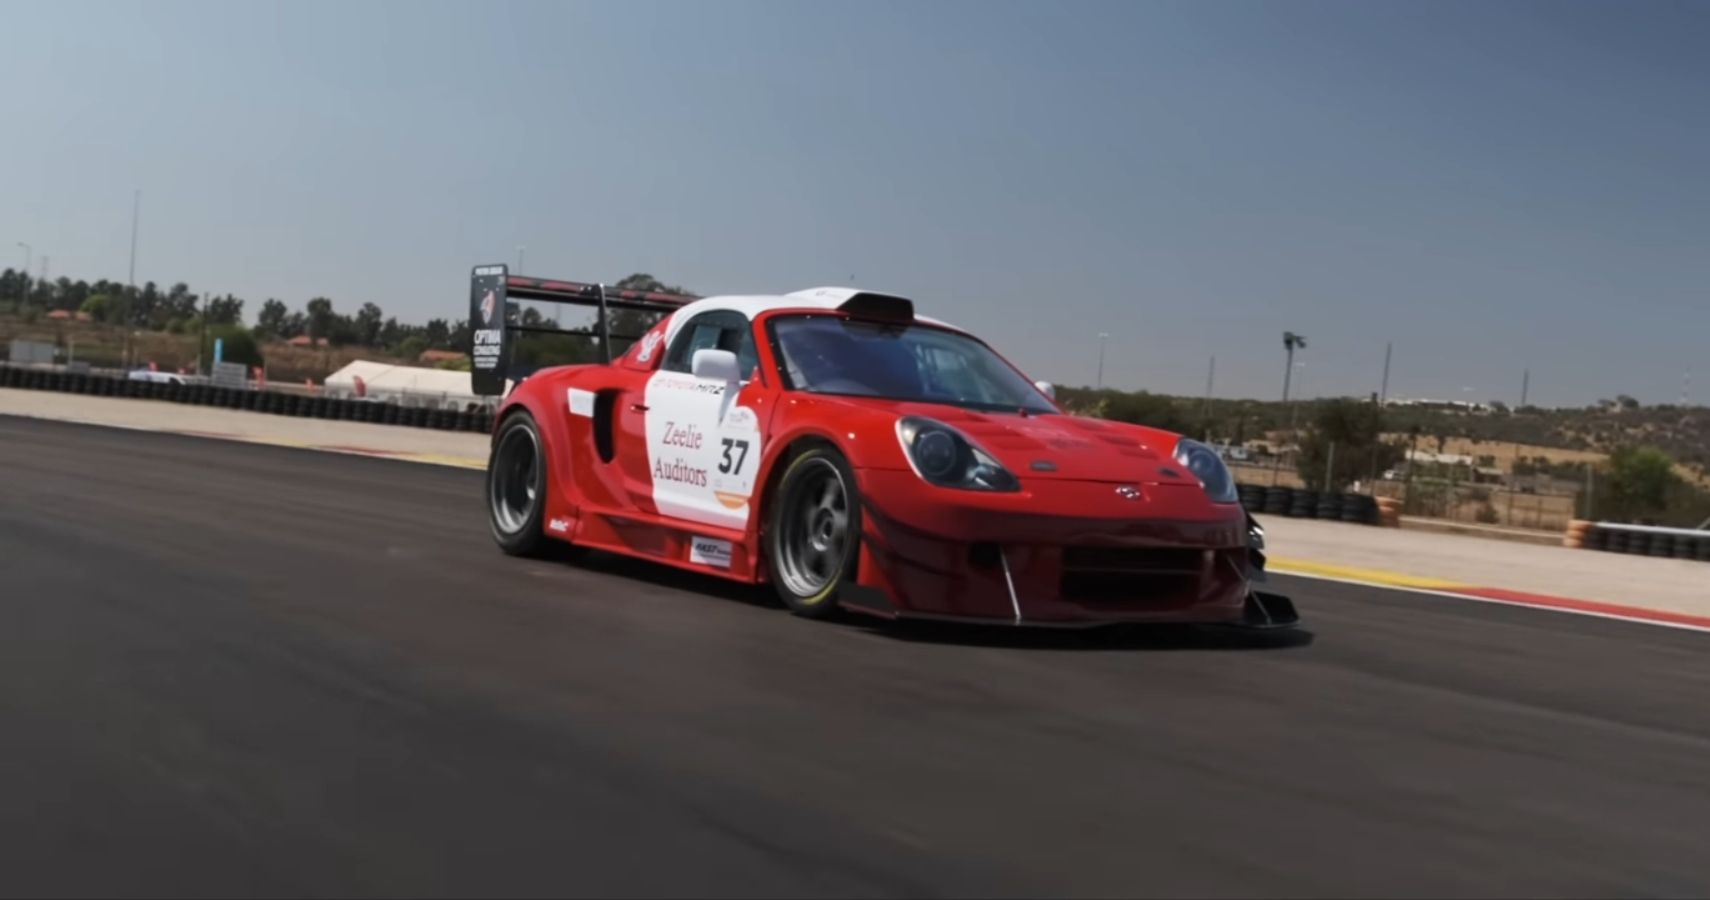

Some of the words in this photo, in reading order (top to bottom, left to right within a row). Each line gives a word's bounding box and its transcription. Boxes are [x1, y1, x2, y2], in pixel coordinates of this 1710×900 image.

[662, 421, 702, 449] Zeelie
[718, 437, 749, 475] 37
[654, 457, 707, 487] Auditors
